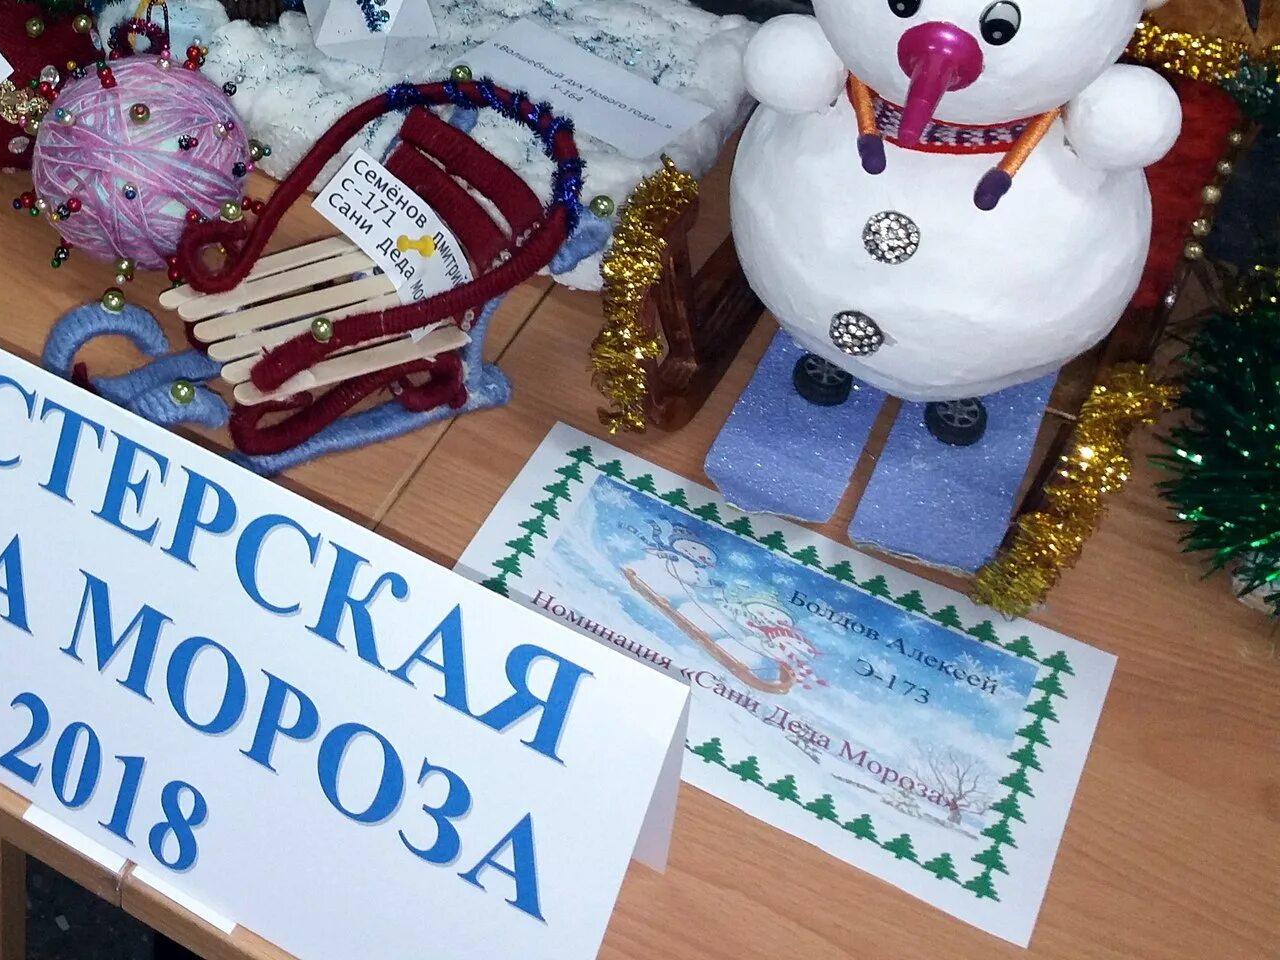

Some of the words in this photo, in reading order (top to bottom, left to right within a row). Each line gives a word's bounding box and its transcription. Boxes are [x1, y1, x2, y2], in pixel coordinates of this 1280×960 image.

[562, 77, 583, 90] дух
[586, 87, 627, 110] Нового
[328, 192, 374, 235] Сани
[376, 237, 415, 281] Деда
[353, 159, 427, 229] Семёнов
[789, 590, 880, 641] Болдов
[886, 638, 998, 695] Алексей
[854, 658, 930, 704] Э-173
[530, 589, 673, 671] Номинация
[680, 667, 761, 713] «Сани
[763, 705, 831, 750] Деда
[839, 740, 960, 813] Мороза»
[60, 569, 549, 924] МОРОЗА
